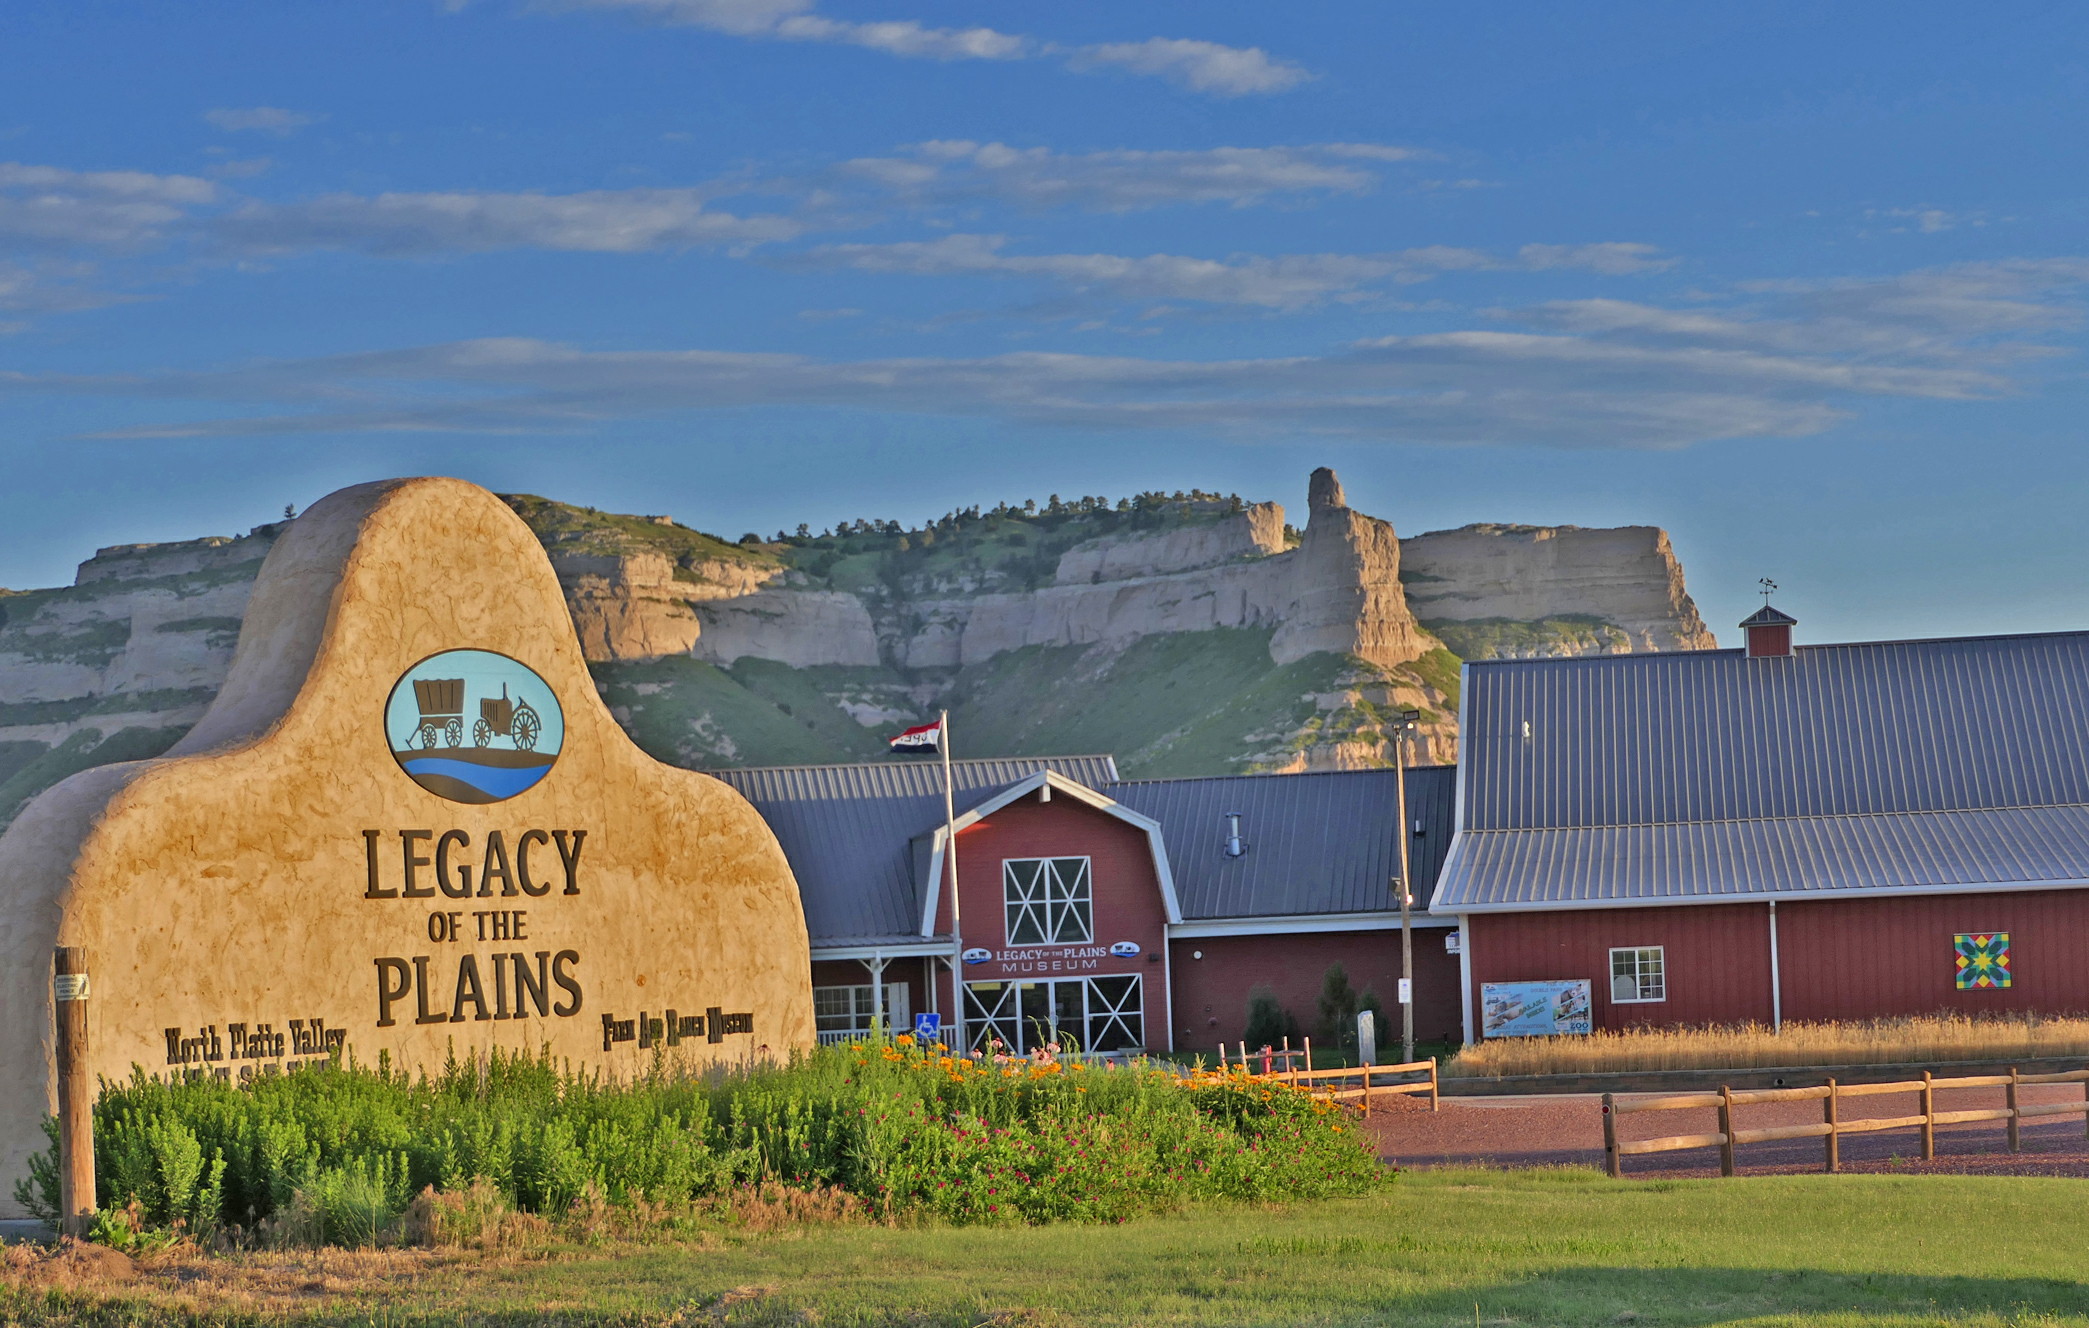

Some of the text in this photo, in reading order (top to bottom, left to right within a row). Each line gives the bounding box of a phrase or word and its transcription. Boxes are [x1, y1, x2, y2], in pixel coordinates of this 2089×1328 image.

[362, 829, 588, 898] LEGACY
[428, 910, 528, 942] OF THE
[996, 950, 1042, 961] LEGACY
[1063, 947, 1107, 958] PLAINS
[1002, 959, 1097, 972] MUSEUM
[374, 949, 583, 1027] PLAINS
[165, 1018, 347, 1064] North Platte Valley
[602, 1013, 636, 1051] FARM
[666, 1009, 705, 1047] RANCH
[706, 1007, 753, 1044] MUSEUM
